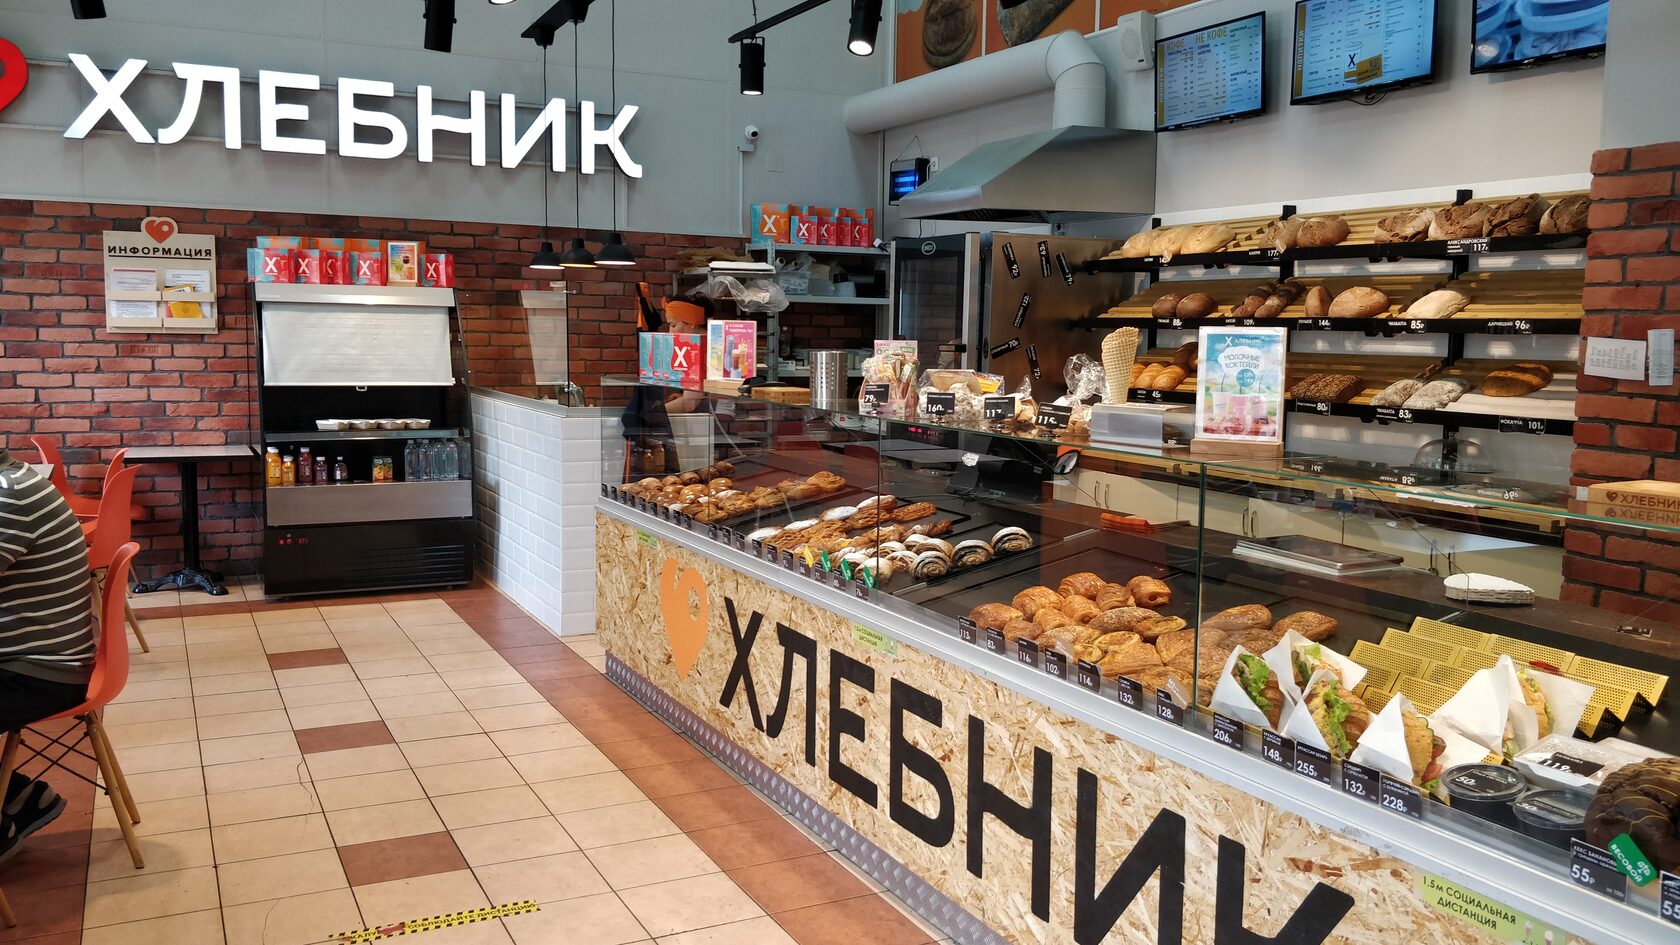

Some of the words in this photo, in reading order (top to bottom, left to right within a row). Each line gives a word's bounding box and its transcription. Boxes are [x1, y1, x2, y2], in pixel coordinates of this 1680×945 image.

[1297, 30, 1305, 71] напитки
[63, 52, 643, 180] ХЛЕБНИК
[107, 245, 212, 258] ИНФОРМАЦИЯ
[1224, 354, 1262, 362] МОЛОЧНЫЕ
[1224, 361, 1260, 369] КОКТЕЙЛИ
[720, 597, 1354, 945] ХЛЕБНИК
[1574, 845, 1587, 855] КЕКС
[1610, 844, 1643, 883] ВЕСОВОЙ
[408, 913, 475, 930] СОБЛЮДАЙТЕ
[477, 903, 536, 918] ДИСТАНЦИЮ
[1437, 896, 1497, 930] ДИСТАНЦИЯ
[1446, 886, 1516, 924] СОЦИАЛЬНАЯ
